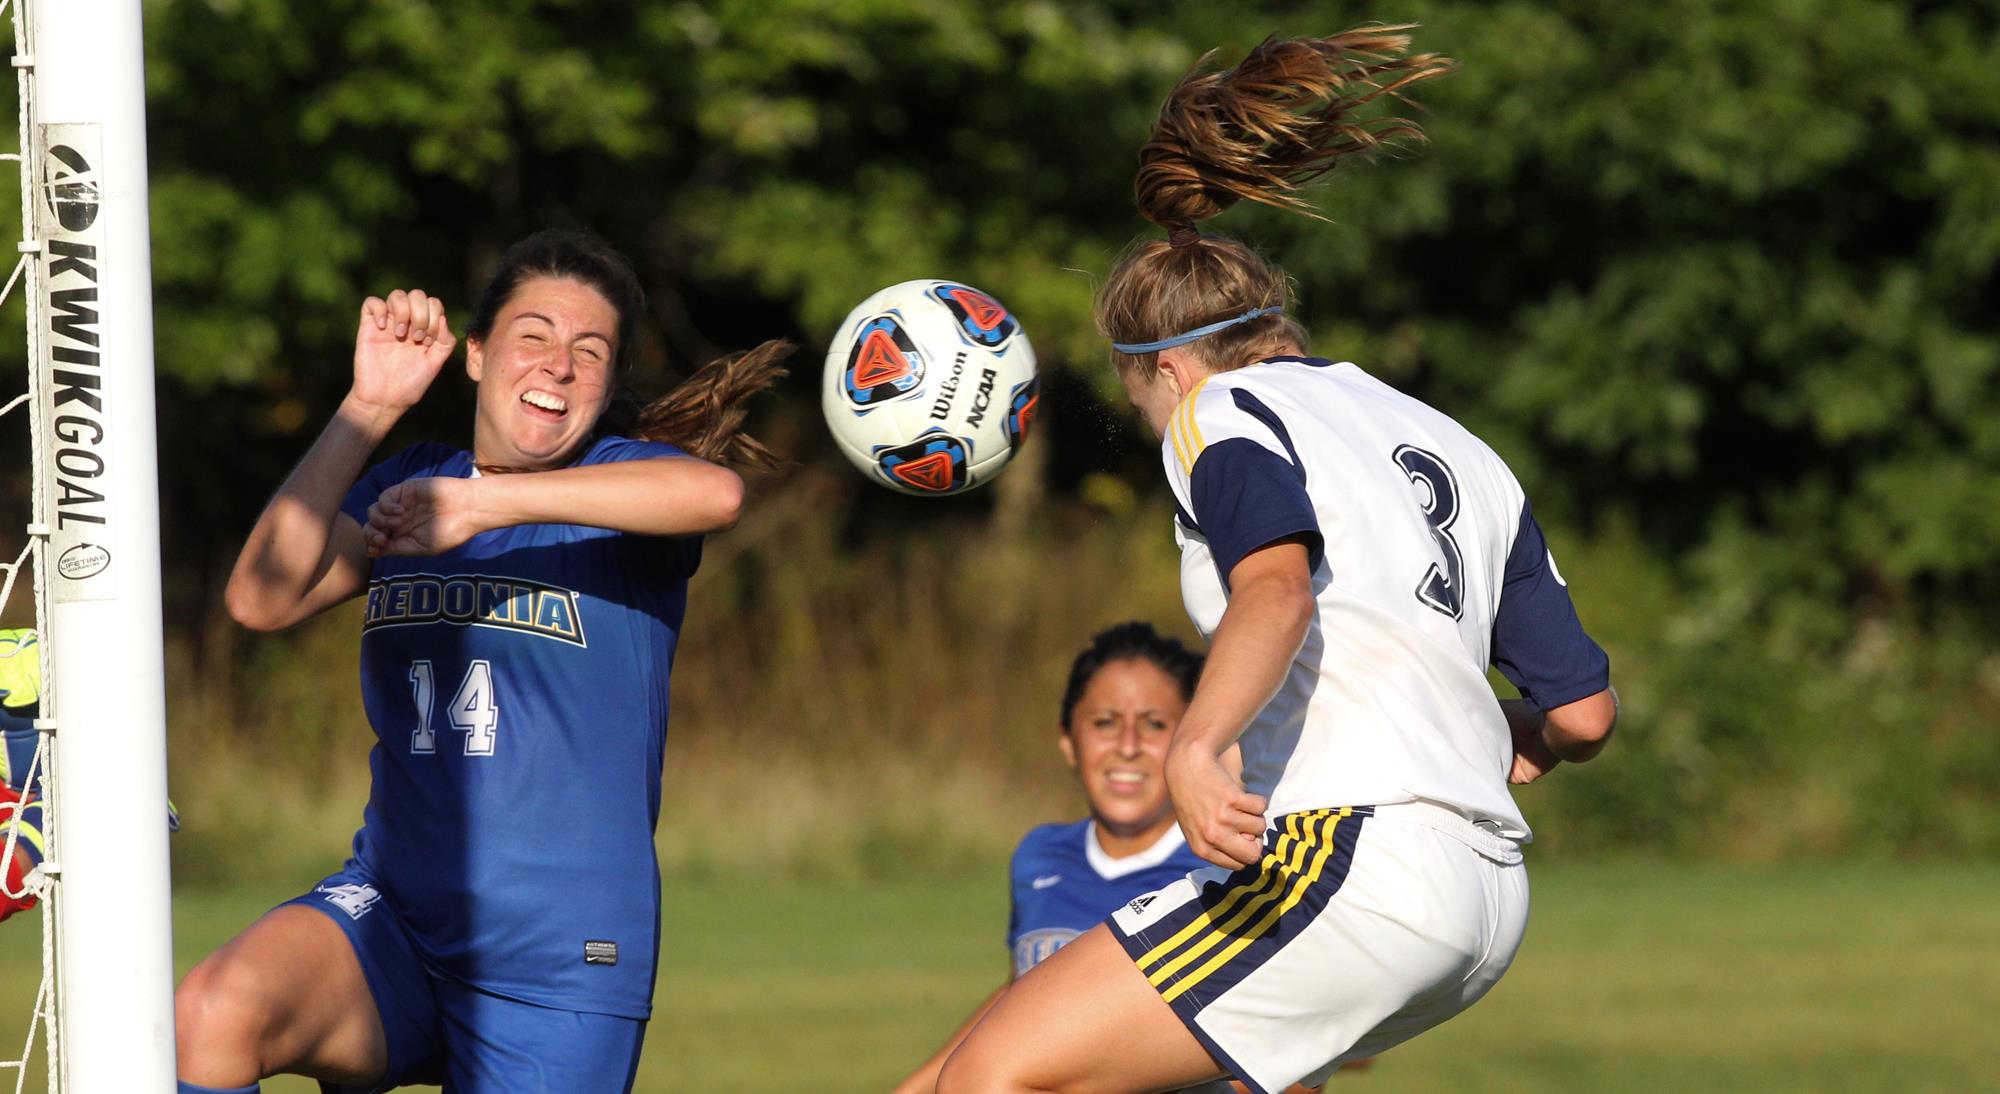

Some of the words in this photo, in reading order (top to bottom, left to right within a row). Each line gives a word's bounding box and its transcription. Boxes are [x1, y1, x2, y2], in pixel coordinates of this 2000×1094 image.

[930, 351, 968, 420] Wilson
[966, 367, 997, 429] NCAA
[1392, 443, 1466, 623] 3
[366, 581, 577, 637] REDONIA
[409, 659, 498, 756] 14
